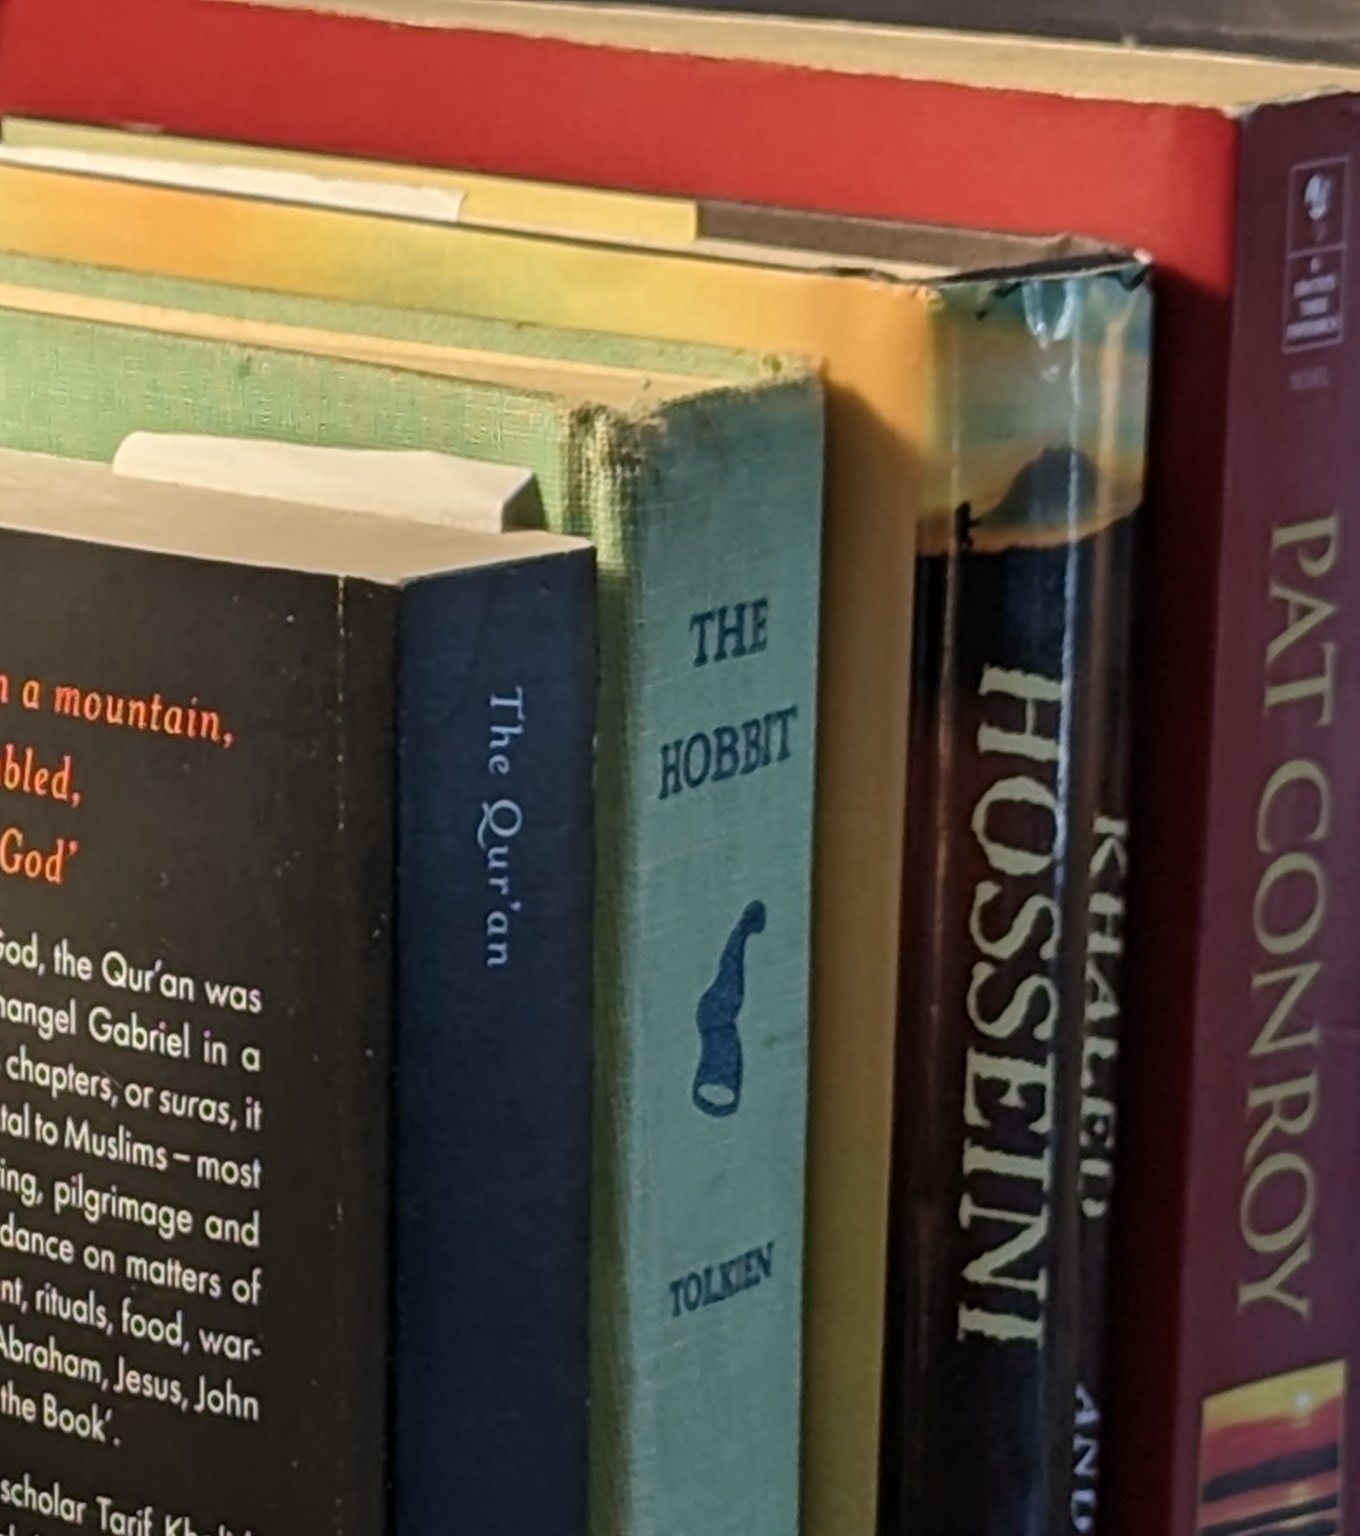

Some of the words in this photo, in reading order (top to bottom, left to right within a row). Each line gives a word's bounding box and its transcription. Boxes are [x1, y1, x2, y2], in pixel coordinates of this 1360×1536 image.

[689, 598, 769, 668] THE
[1263, 512, 1340, 727] PAT
[22, 679, 41, 710] a
[53, 685, 232, 748] mountain,
[487, 686, 526, 776] The
[657, 704, 800, 801] HOBBIT
[476, 798, 525, 969] Qur'an
[53, 938, 93, 981] the
[101, 950, 194, 1001] Qur'an
[204, 981, 262, 1013] was
[957, 661, 1064, 1350] HOSSEINI
[88, 1006, 189, 1058] Gabriel
[203, 1030, 227, 1066] in
[241, 1046, 260, 1072] a
[1078, 811, 1130, 1219] KHALED
[1235, 756, 1333, 1321] CONROY
[5, 1044, 118, 1107] chapters,
[124, 1083, 154, 1108] or
[158, 1089, 237, 1132] suras,
[245, 1095, 262, 1131] it
[34, 1112, 58, 1146] to
[64, 1116, 168, 1171] Muslims
[196, 1155, 261, 1188] most
[54, 1172, 193, 1240] pilgrimage
[204, 1210, 259, 1247] and
[84, 1241, 115, 1274] on
[126, 1255, 221, 1298] matters
[231, 1267, 262, 1305] of
[35, 1282, 113, 1335] rituals,
[121, 1296, 190, 1353] food,
[198, 1328, 261, 1361] war-
[0, 1379, 37, 1422] the
[112, 1355, 188, 1411] Jesus,
[193, 1375, 259, 1421] John
[1070, 1384, 1102, 1533] AND
[0, 1473, 86, 1524] scholar
